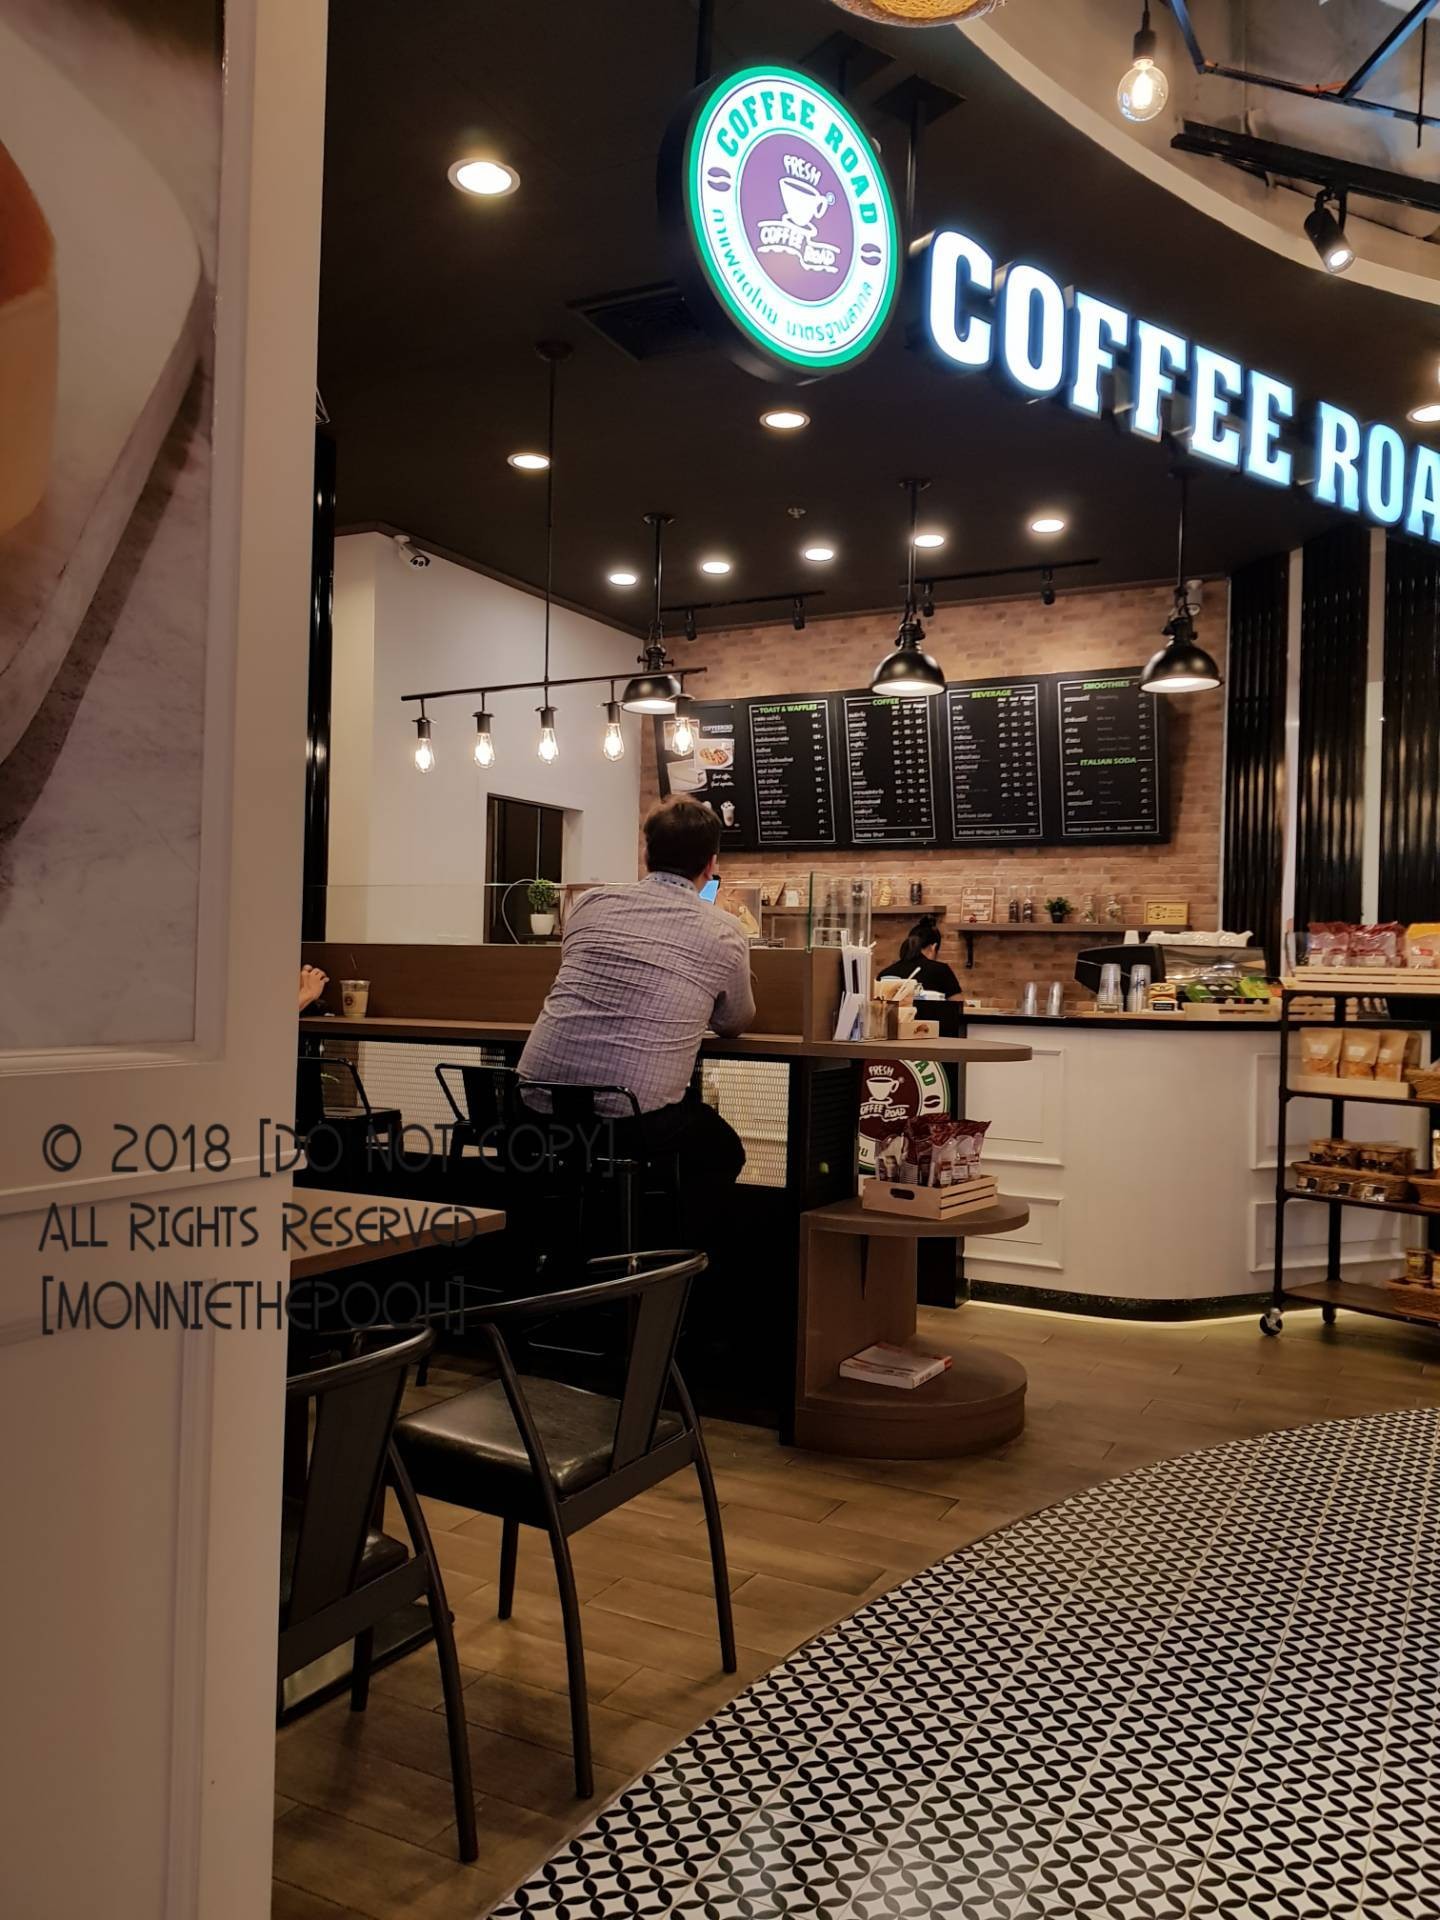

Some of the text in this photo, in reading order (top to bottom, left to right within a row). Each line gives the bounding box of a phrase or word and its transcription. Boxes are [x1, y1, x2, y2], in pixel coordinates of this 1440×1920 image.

[716, 90, 878, 225] COFFEE ROAD
[783, 153, 822, 186] FRESH
[760, 226, 835, 265] COFFEE ROAD
[928, 229, 1294, 486] COFFEE
[1082, 680, 1130, 690] SMOOTHIES
[971, 689, 1012, 699] BEVERAGE
[872, 697, 900, 706] COFFEE
[759, 706, 781, 714] TOAST
[787, 704, 818, 712] WAFFLES
[1079, 756, 1137, 767] ITALIAN SODA
[868, 1066, 894, 1076] FRESH
[884, 1108, 906, 1118] ROAD
